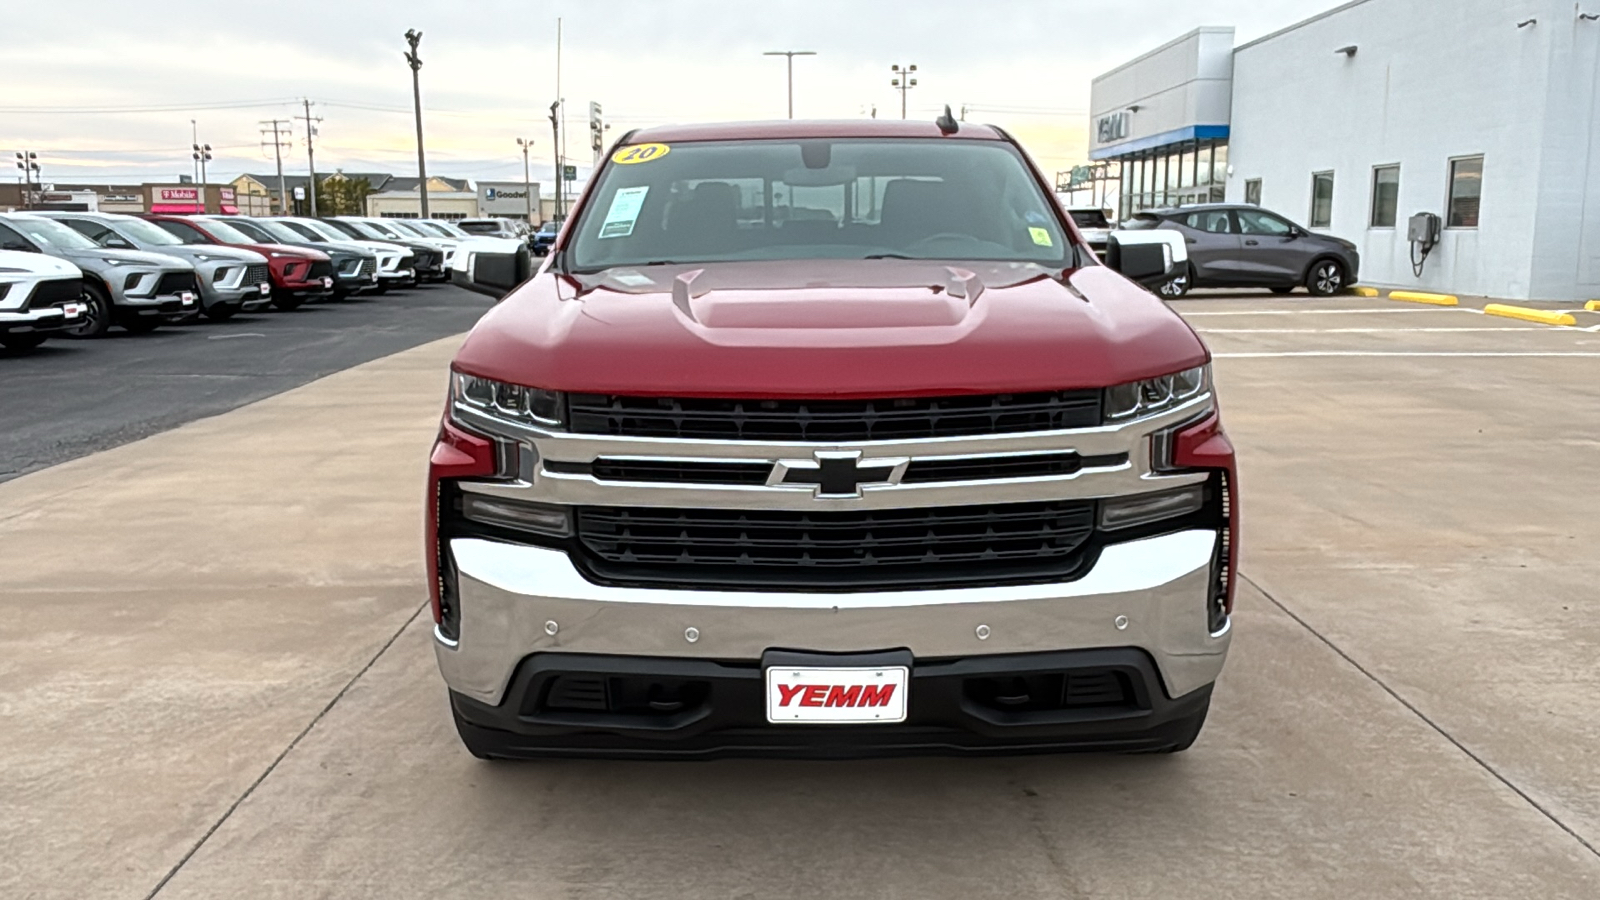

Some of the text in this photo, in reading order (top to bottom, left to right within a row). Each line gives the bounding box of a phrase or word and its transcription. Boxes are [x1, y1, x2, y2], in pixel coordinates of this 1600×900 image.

[622, 146, 658, 161] 20
[496, 190, 530, 199] Goodwi
[777, 684, 897, 707] YEMM
